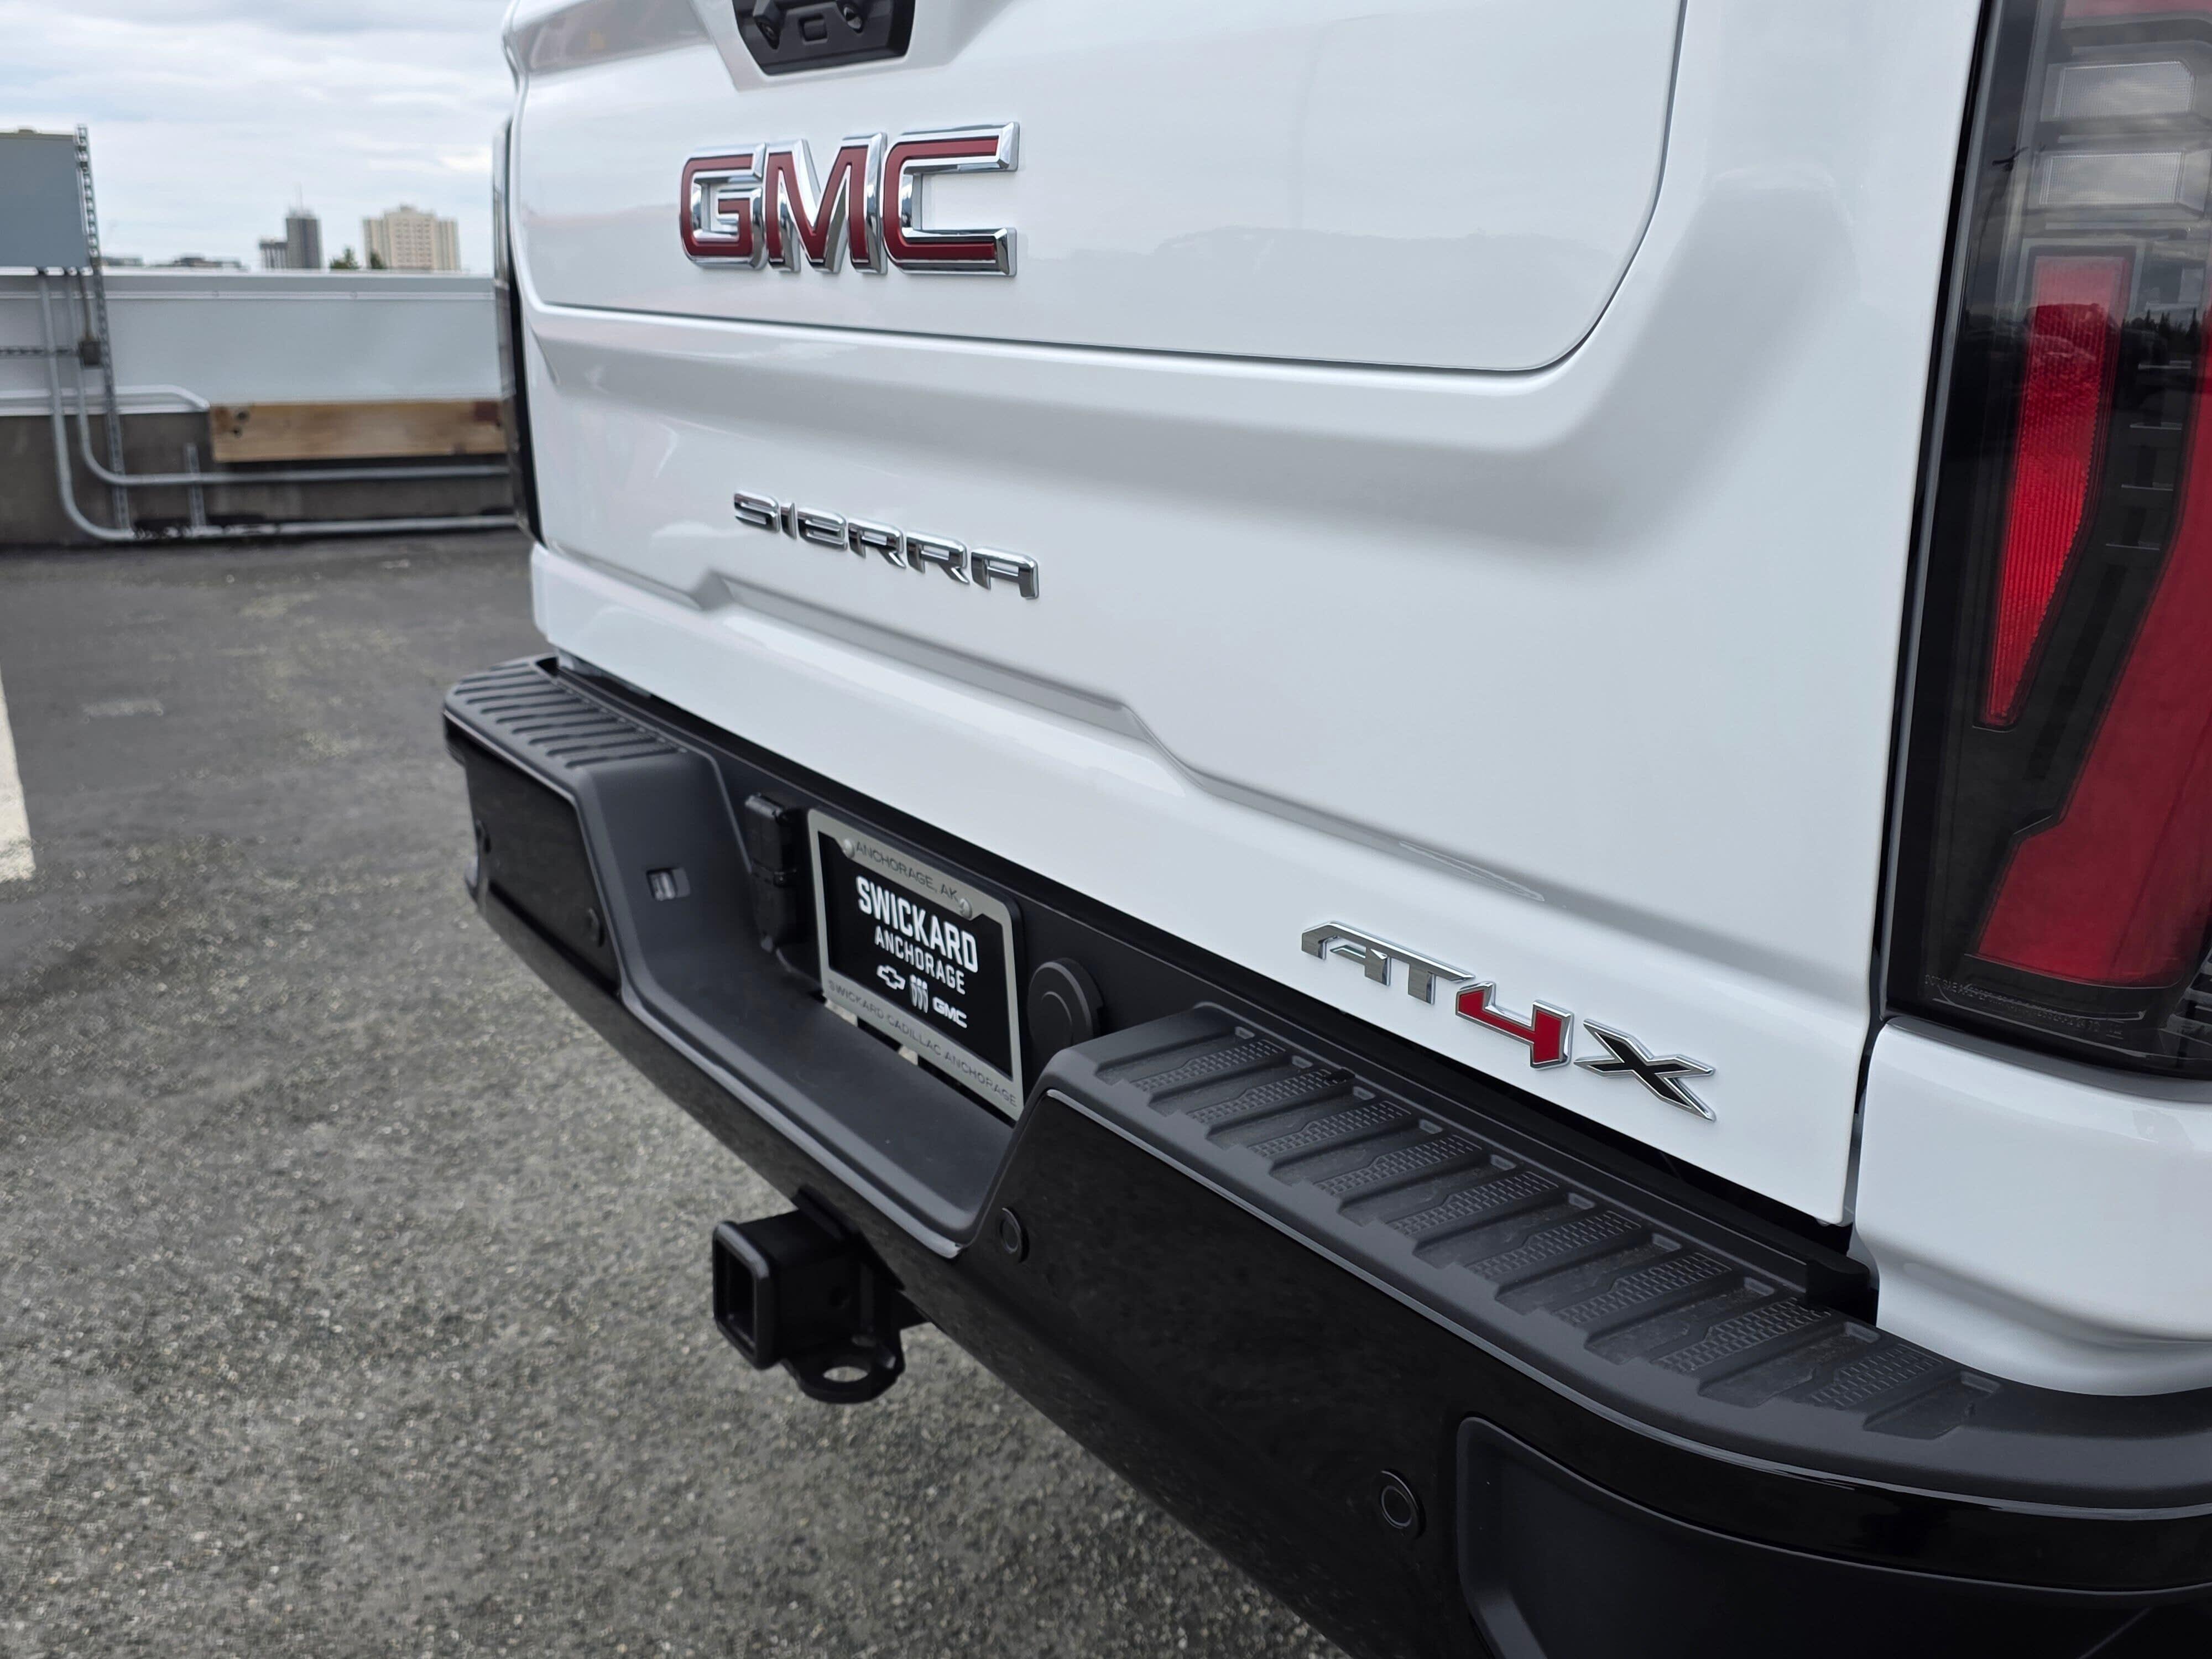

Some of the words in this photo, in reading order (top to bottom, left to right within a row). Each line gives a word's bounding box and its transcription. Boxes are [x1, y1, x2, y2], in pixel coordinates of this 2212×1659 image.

[680, 122, 1020, 276] GMC
[733, 489, 1040, 600] SIERRA
[856, 875, 978, 973] SWICKARD
[940, 884, 958, 902] AK
[875, 925, 966, 995] ANCHORAGE
[932, 996, 967, 1028] GMC
[828, 979, 884, 1020] SWICKARD
[886, 1015, 941, 1056] CADILLAC
[945, 1051, 1018, 1108] ANCHORAGE
[1301, 920, 1717, 1122] AT4X
